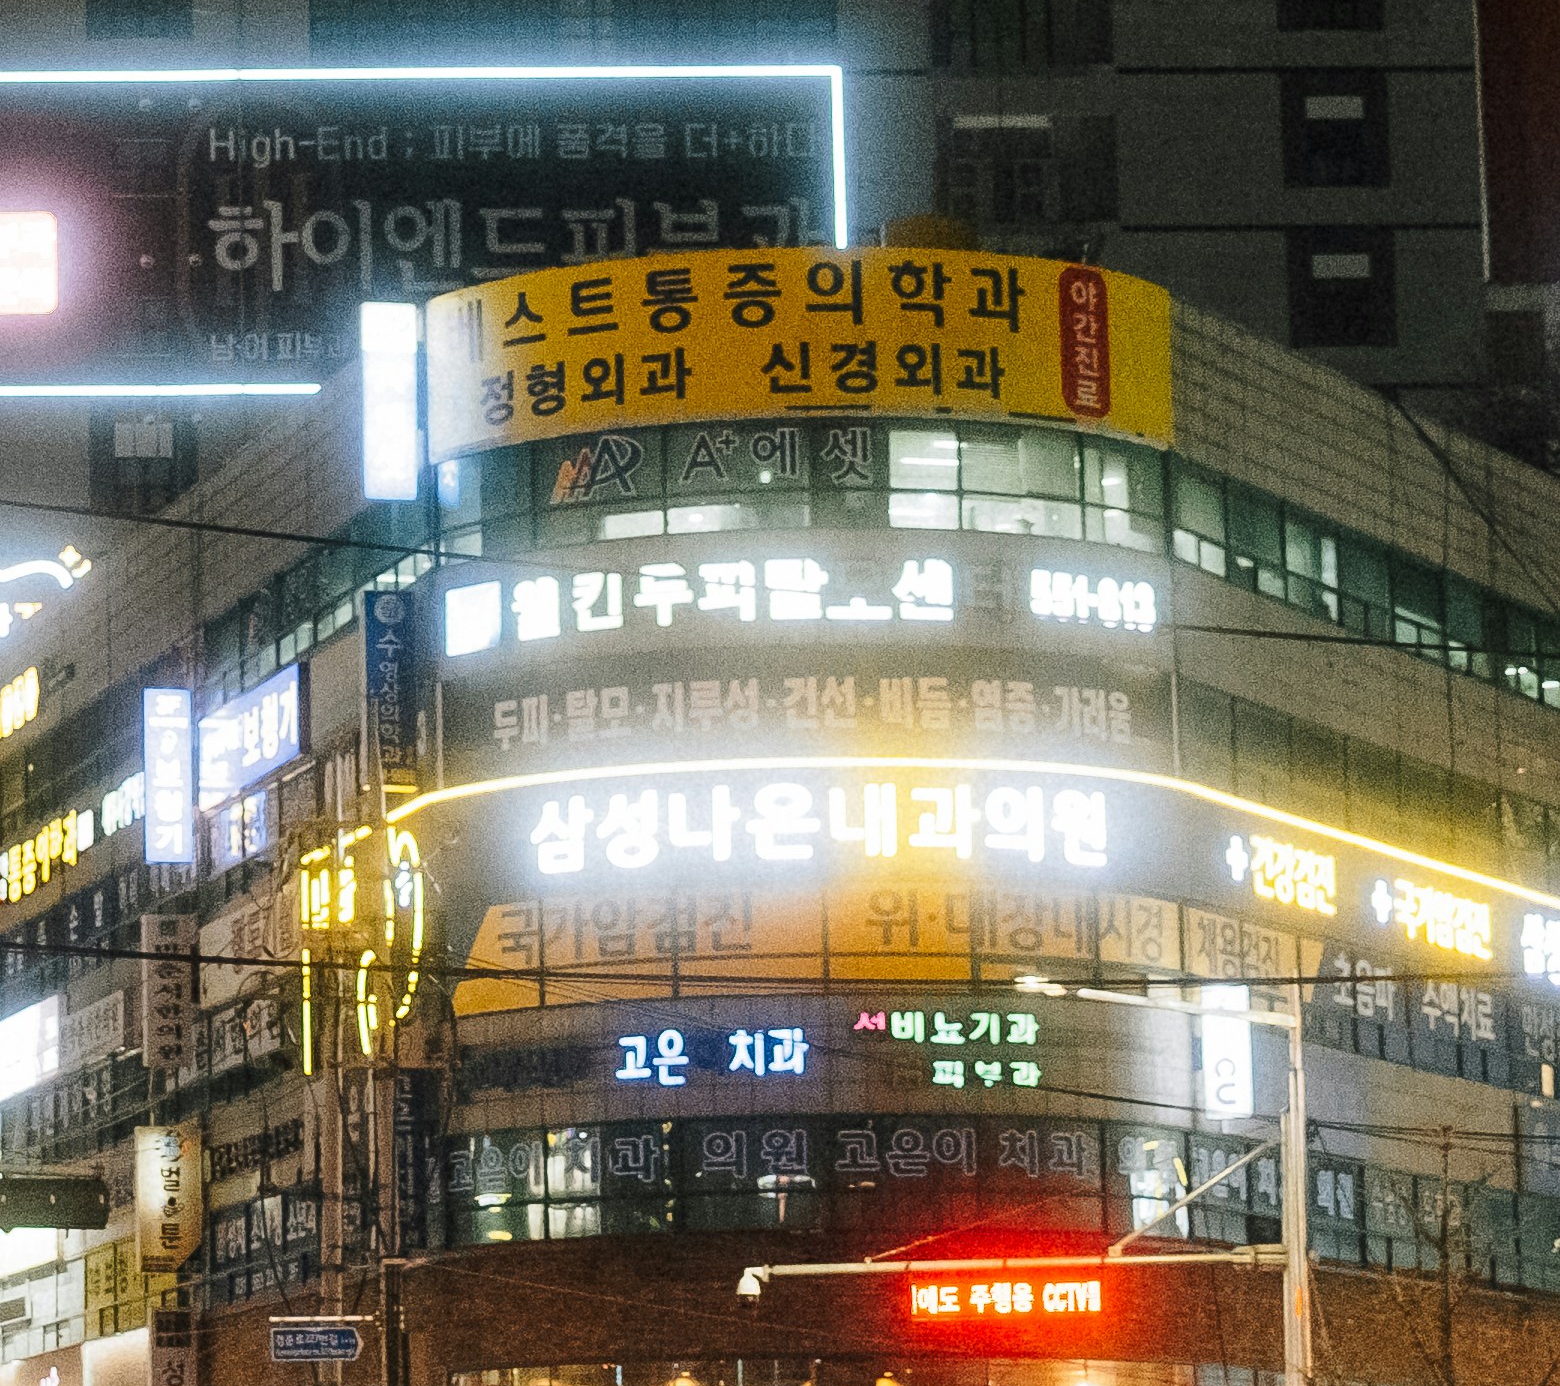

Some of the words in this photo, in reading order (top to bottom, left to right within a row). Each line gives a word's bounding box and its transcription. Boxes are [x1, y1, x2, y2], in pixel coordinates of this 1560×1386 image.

[208, 124, 388, 169] High-End
[431, 125, 539, 161] 피부에
[557, 123, 666, 161] 품격을
[480, 348, 693, 426] 정형외과
[761, 342, 1006, 400] 신경외과
[530, 780, 1109, 876] 삼성나은내과의원
[497, 893, 754, 960] 국가암검진
[617, 1029, 689, 1086] 고은
[729, 1028, 810, 1076] 치과
[933, 1061, 1041, 1089] 피부과
[835, 1125, 978, 1178] 고은이
[1000, 1130, 1092, 1179] 치과
